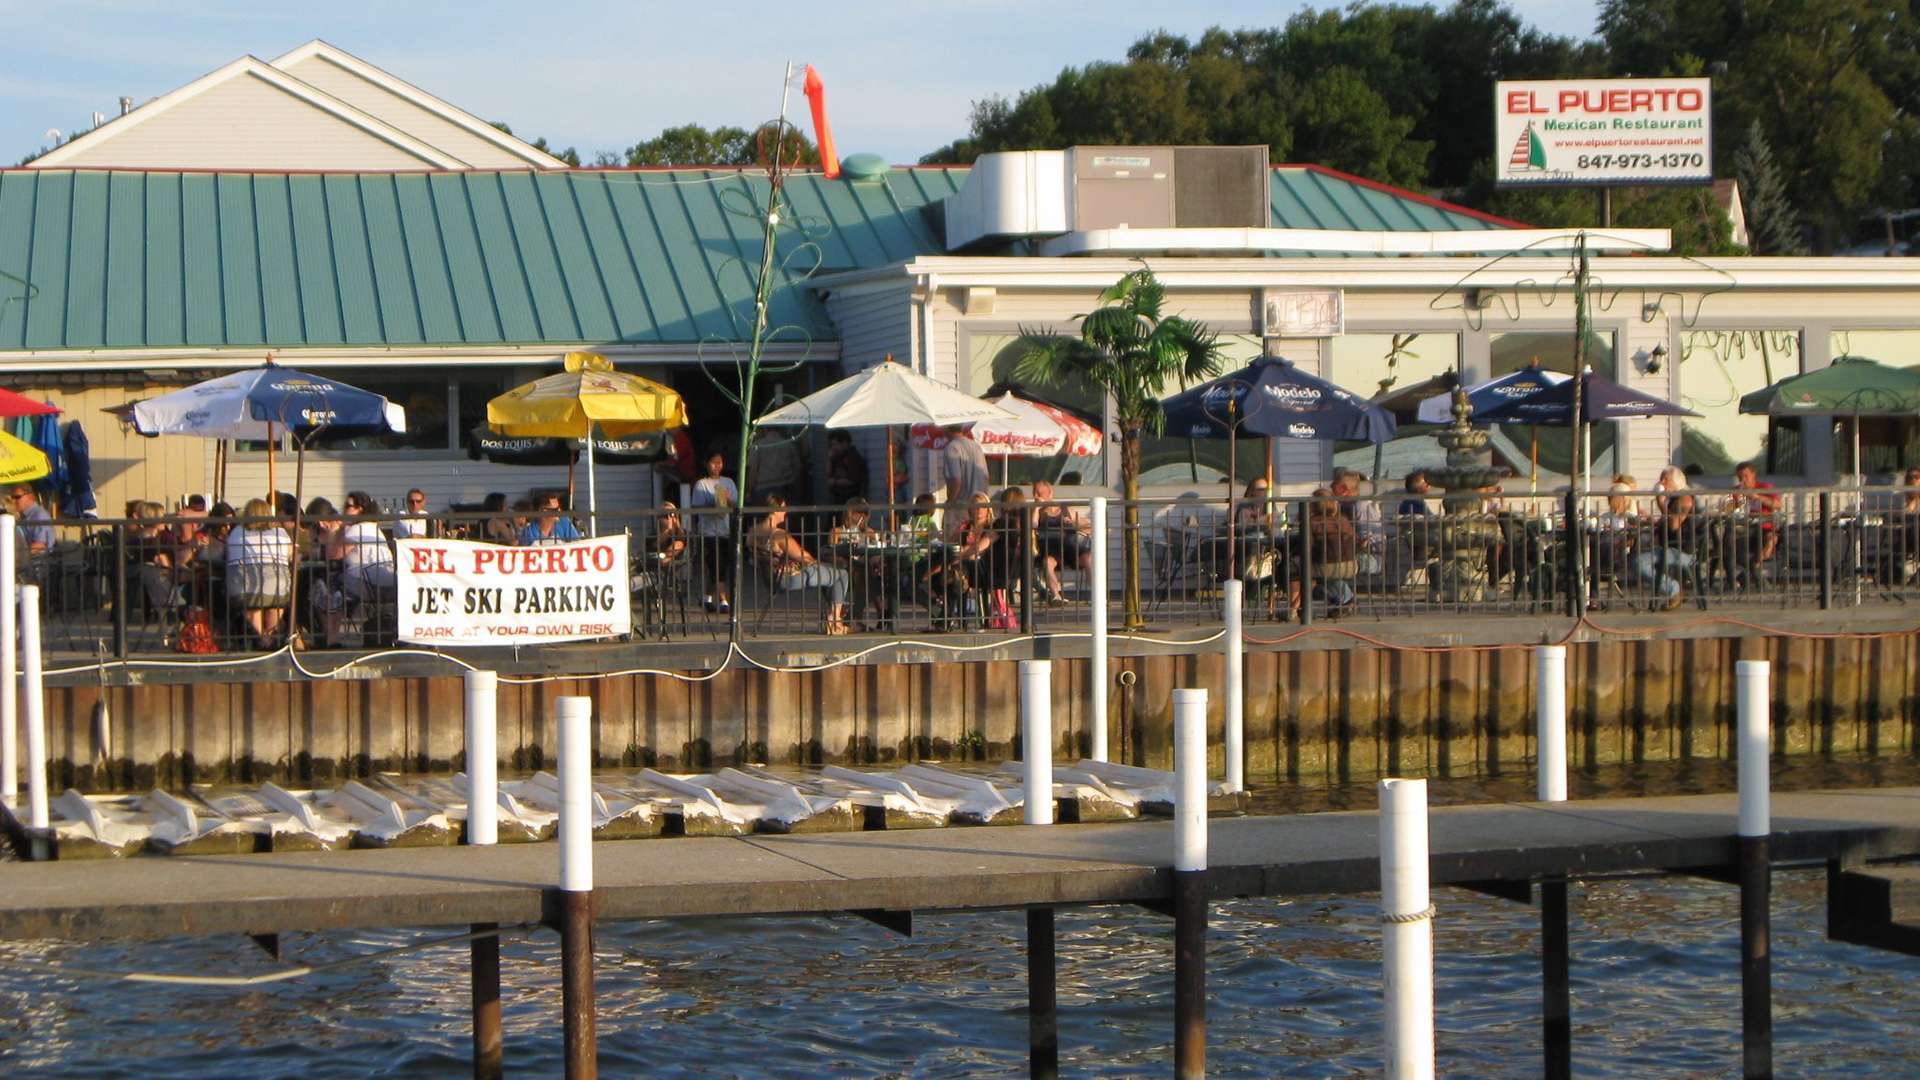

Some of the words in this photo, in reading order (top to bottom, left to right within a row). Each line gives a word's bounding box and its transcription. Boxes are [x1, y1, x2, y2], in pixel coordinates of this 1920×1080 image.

[1507, 90, 1549, 114] EL
[1559, 88, 1704, 113] PUERTO
[1544, 119, 1607, 131] Mexican
[1613, 118, 1703, 130] Restaurant
[1555, 137, 1703, 148] www.elpuertorestaurant.net
[1577, 153, 1703, 169] 847-973-1370
[1265, 384, 1322, 399] Modelo
[480, 439, 502, 449] DOS
[503, 439, 532, 450] EQUIS
[980, 430, 1060, 446] Budweiser
[409, 547, 456, 574] EL
[472, 545, 615, 575] PUERTO
[412, 586, 453, 615] JET
[464, 586, 502, 614] SKI
[514, 584, 615, 614] PARKING
[414, 626, 455, 638] PARK
[462, 626, 481, 638] AT
[487, 625, 529, 637] YOUR
[535, 624, 574, 636] OWN
[579, 623, 614, 635] RISK
